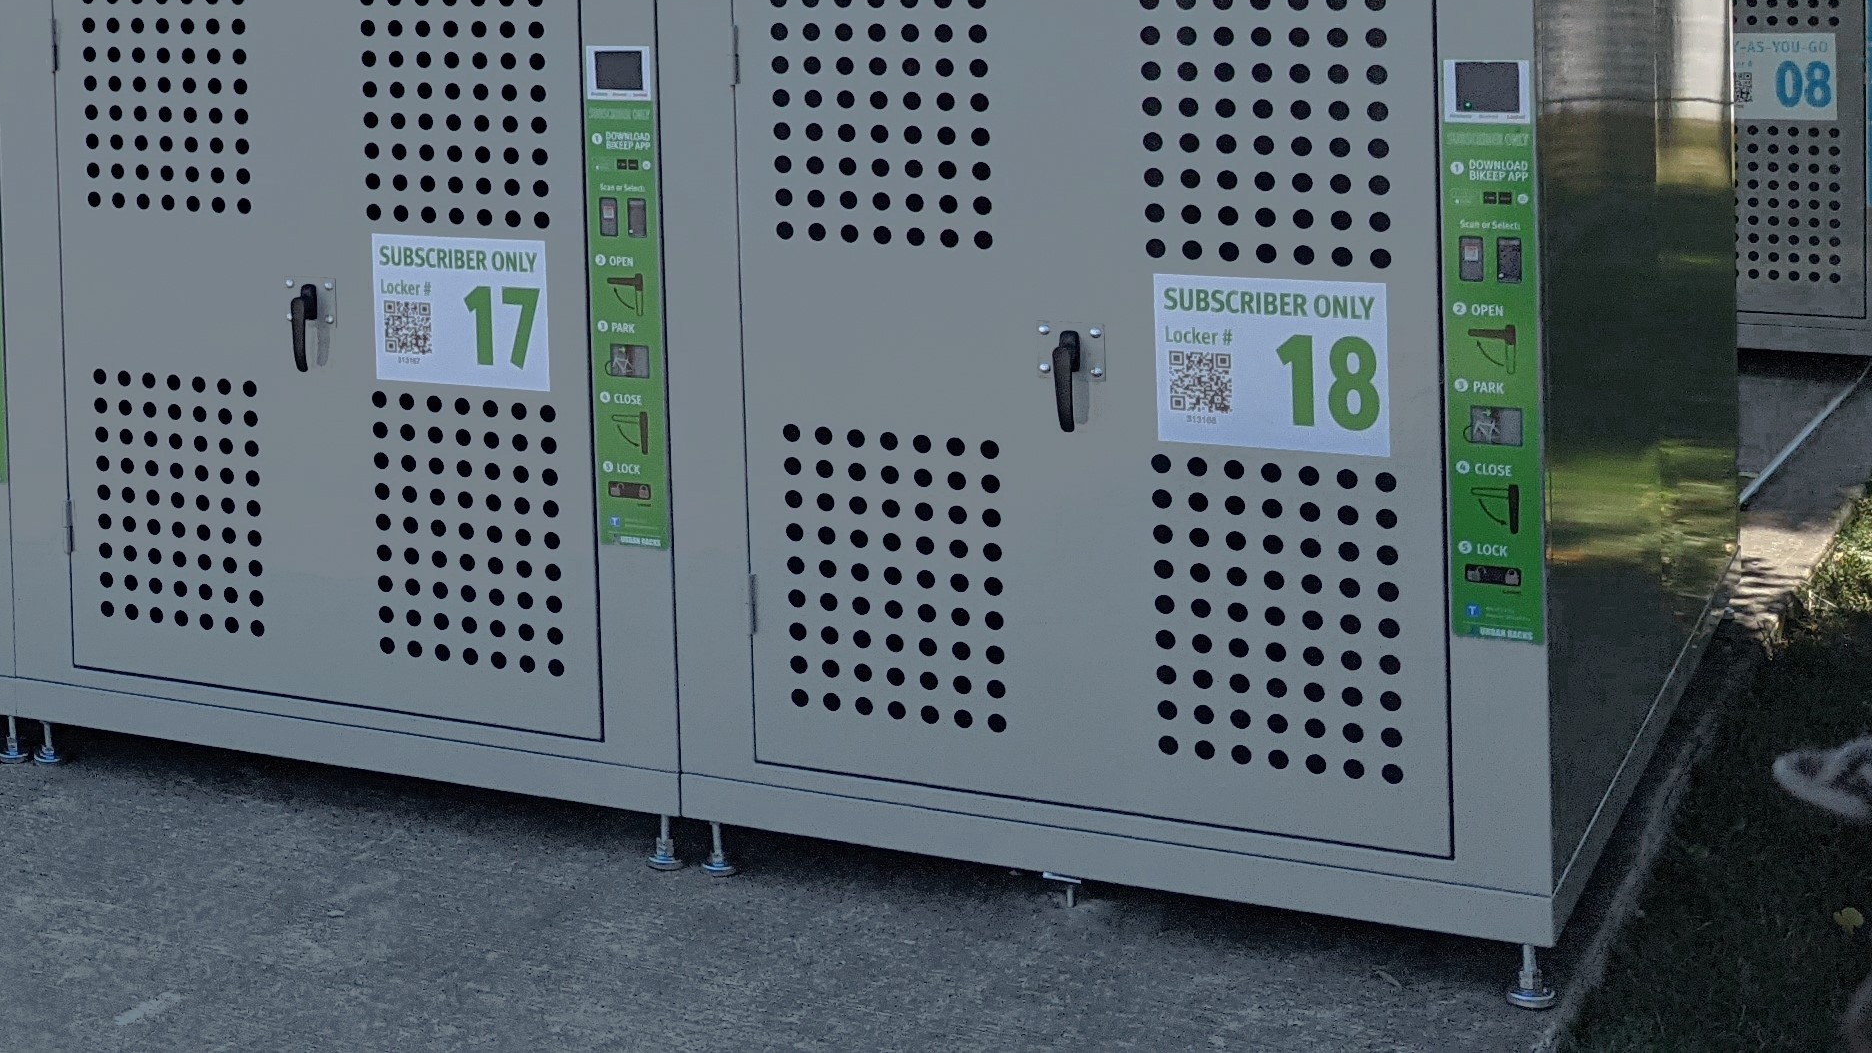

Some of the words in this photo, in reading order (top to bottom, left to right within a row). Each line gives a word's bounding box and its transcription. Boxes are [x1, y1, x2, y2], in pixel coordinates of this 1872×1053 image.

[1776, 60, 1832, 108] 08
[606, 131, 651, 142] DOWNLOAD
[634, 141, 651, 151] APP
[1468, 159, 1528, 171] DOWNLOAD
[1508, 171, 1529, 182] APP
[1459, 219, 1480, 228] Scan
[379, 245, 488, 271] SUBSCRIBER
[491, 251, 538, 273] ONLY
[609, 256, 634, 267] OPEN
[380, 279, 421, 296] Locker
[423, 281, 432, 296] #
[1163, 287, 1308, 318] SUBSCRIBER
[1313, 295, 1376, 321] ONLY
[1471, 303, 1504, 317] OPEN
[463, 285, 541, 370] 17
[611, 322, 635, 334] PARK
[1165, 325, 1219, 346] Locker
[1222, 329, 1233, 346] #
[1275, 334, 1381, 432] 18
[1473, 381, 1505, 394] PARK
[613, 393, 643, 406] CLOSE
[616, 463, 641, 475] LOCK
[1474, 463, 1512, 477] CLOSE
[1477, 544, 1508, 557] LOCK
